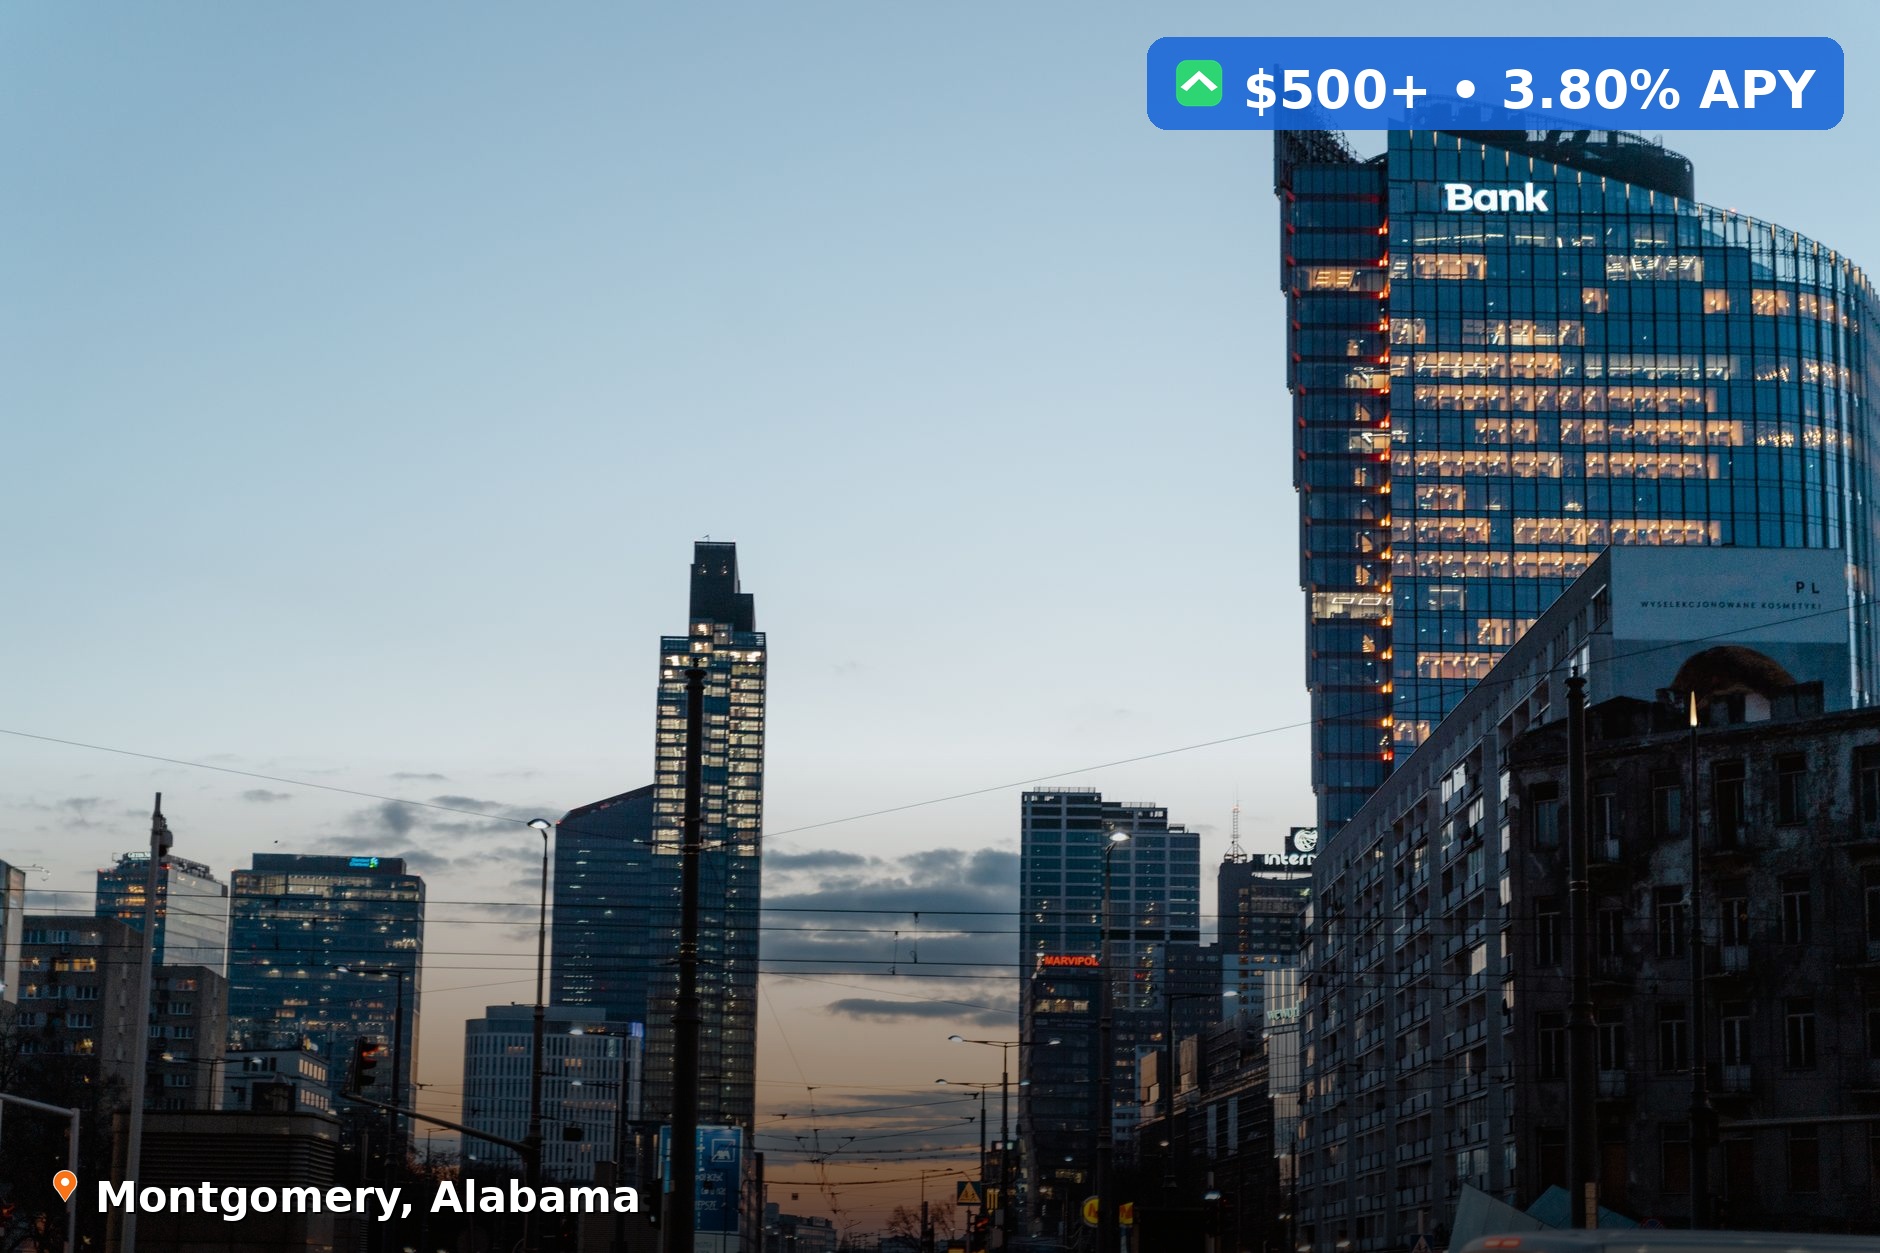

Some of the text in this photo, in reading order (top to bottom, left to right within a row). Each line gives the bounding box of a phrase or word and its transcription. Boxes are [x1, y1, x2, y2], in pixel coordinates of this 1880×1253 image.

[1445, 183, 1549, 212] Bank
[1640, 600, 1821, 610] WYSELEKCJONOWANE KOSMETYKI
[1043, 955, 1100, 966] MARVIPOL
